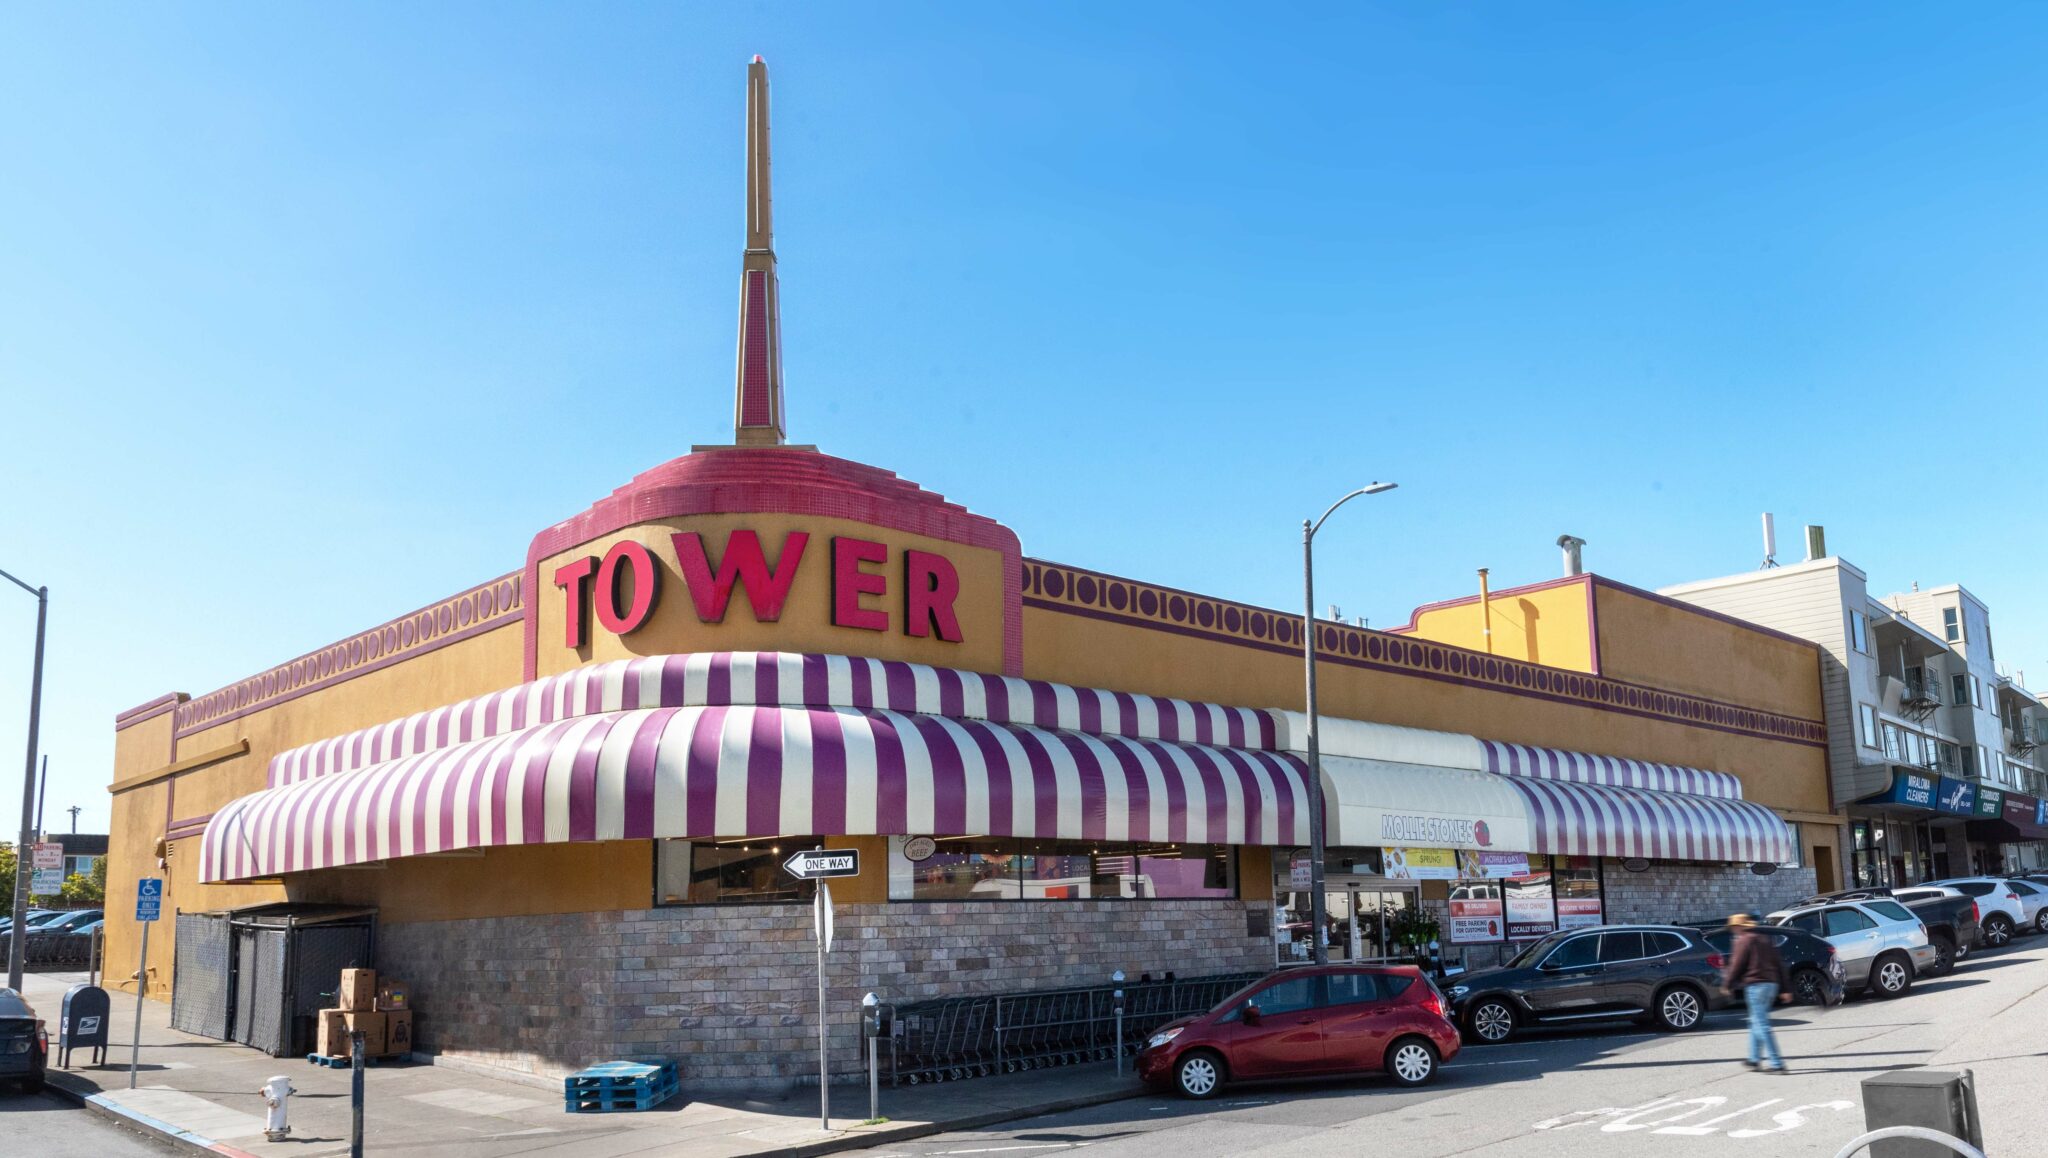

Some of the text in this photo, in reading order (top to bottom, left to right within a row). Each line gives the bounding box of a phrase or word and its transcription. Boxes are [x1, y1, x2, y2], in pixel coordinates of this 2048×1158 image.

[555, 530, 964, 648] TOWER
[1906, 789, 1929, 803] CLEANERS
[1382, 814, 1475, 843] MOLLIE STONE'S
[912, 848, 928, 858] BEEF
[805, 857, 851, 870] ONE WAY
[33, 870, 41, 879] 2
